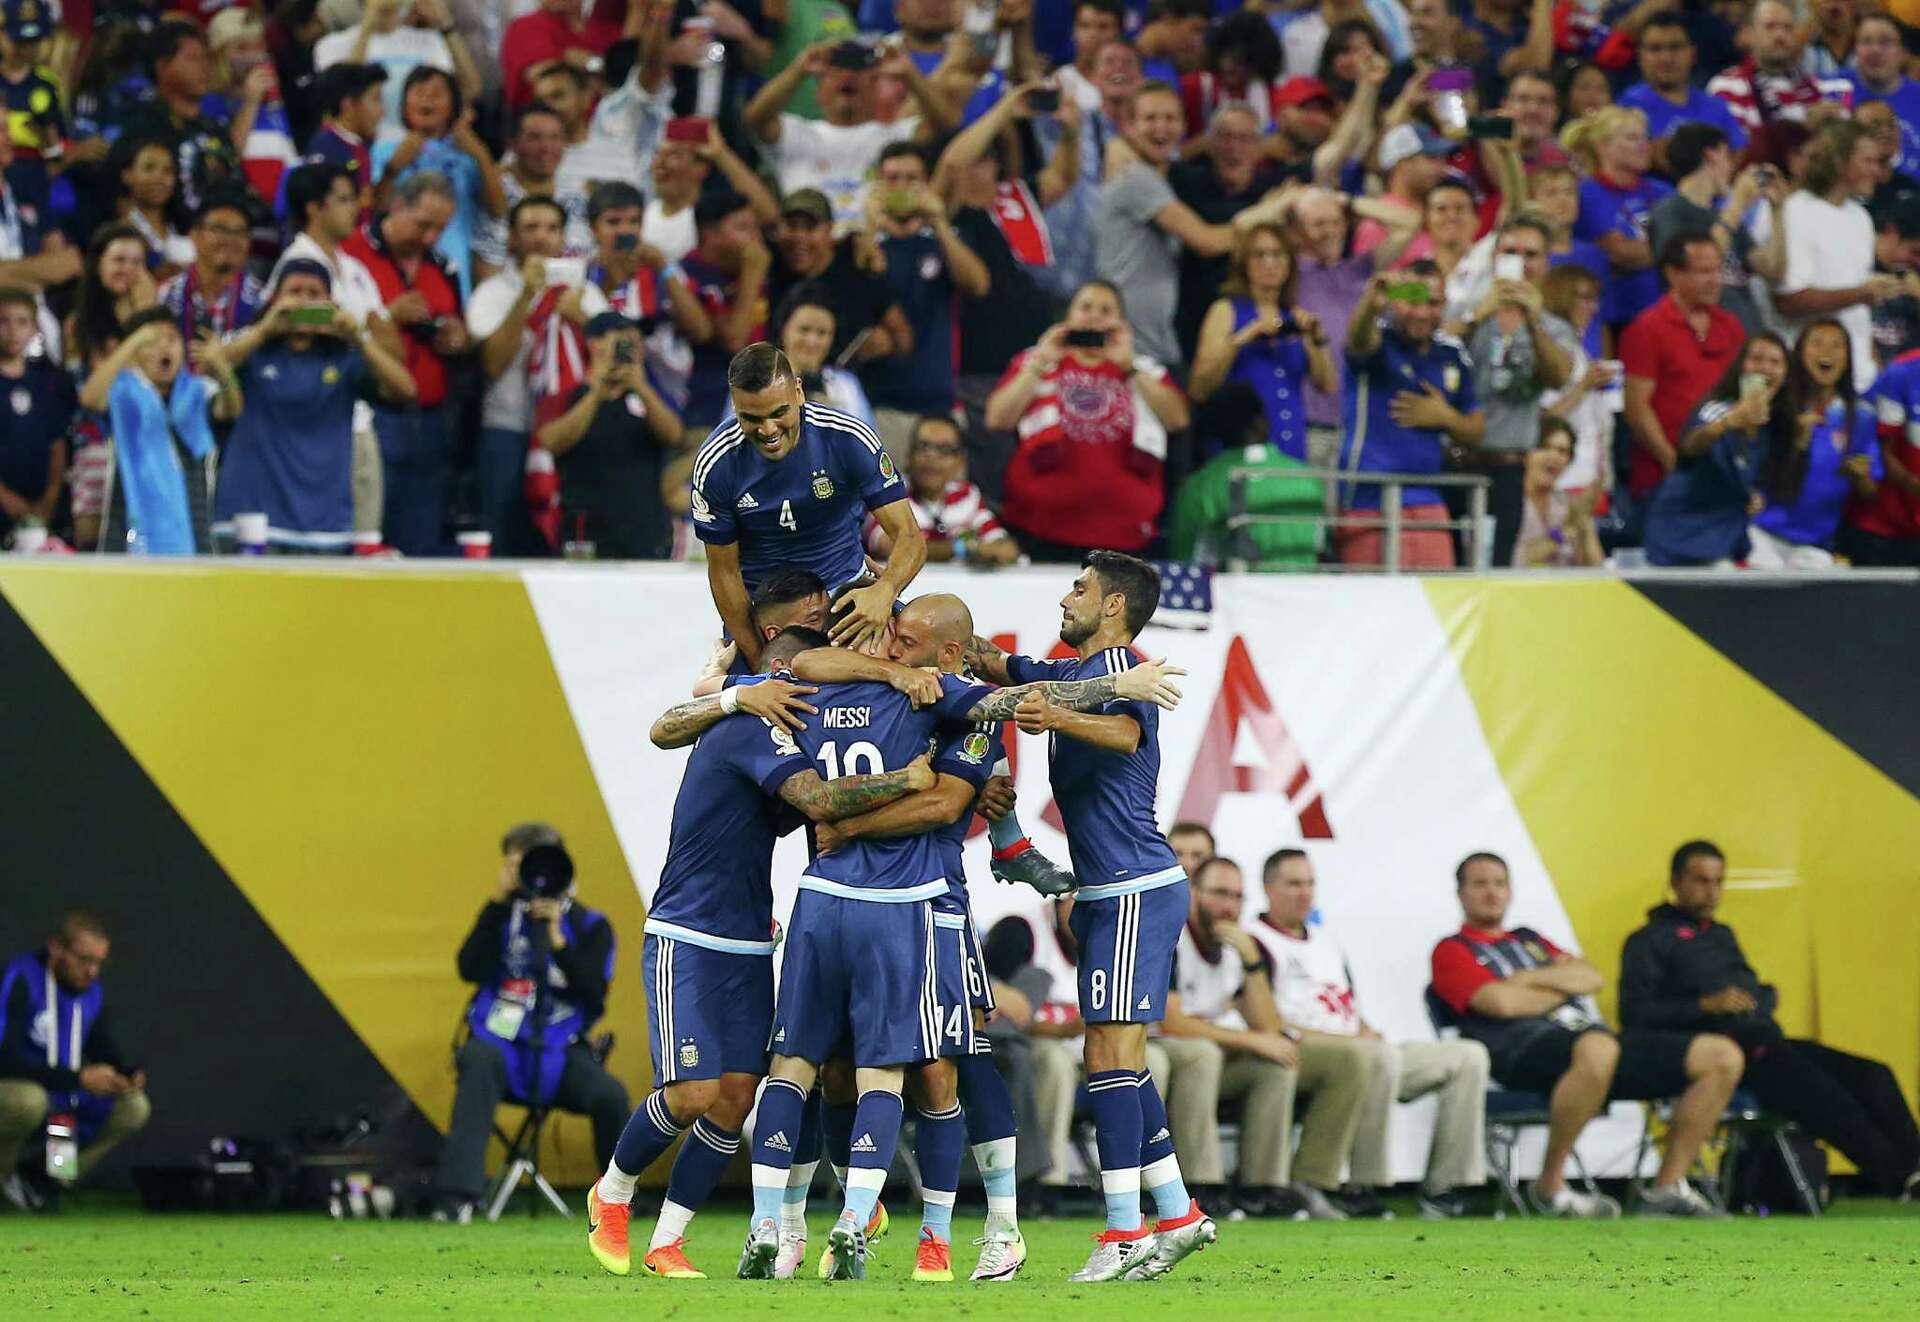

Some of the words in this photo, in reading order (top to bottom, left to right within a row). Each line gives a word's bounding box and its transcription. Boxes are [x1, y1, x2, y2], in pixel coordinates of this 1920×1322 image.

[779, 499, 797, 532] 4
[823, 706, 872, 729] MESSI
[1091, 968, 1107, 1011] 8
